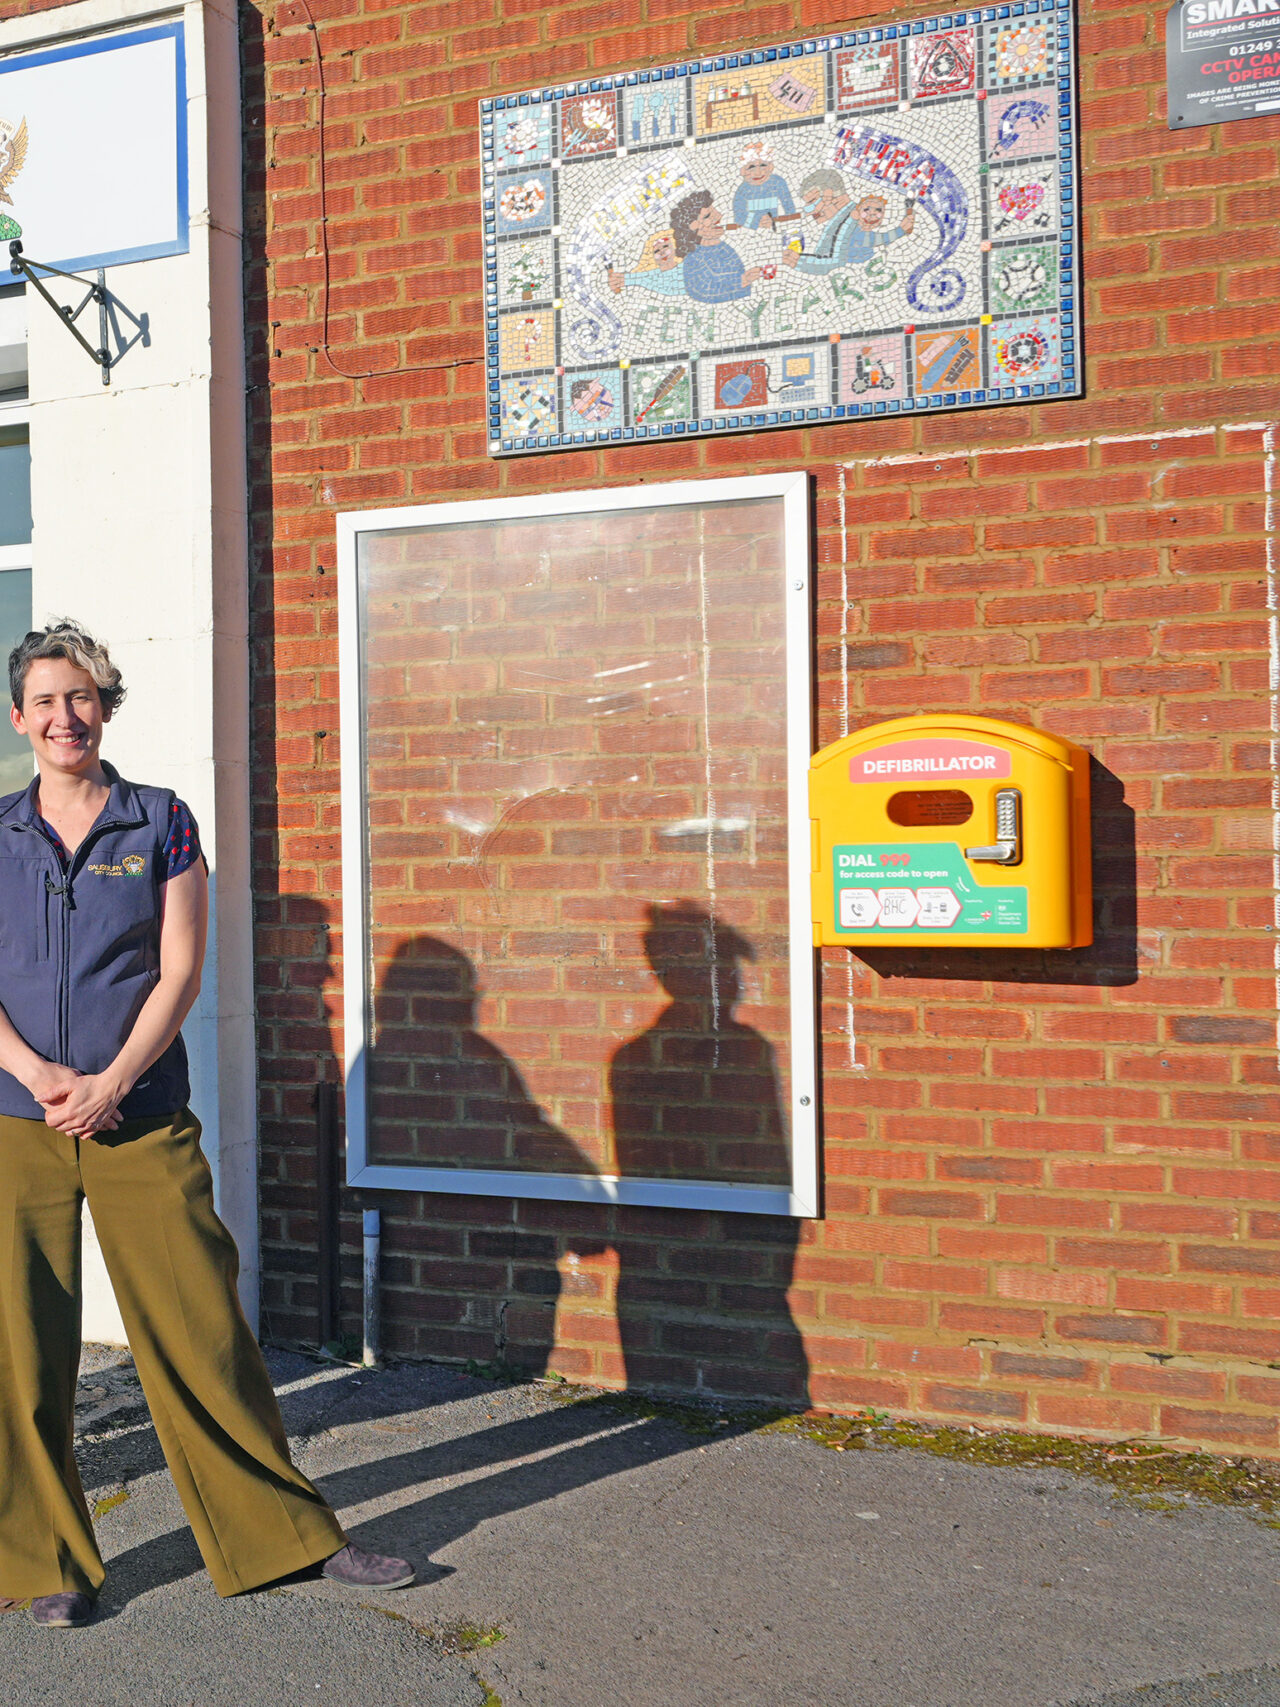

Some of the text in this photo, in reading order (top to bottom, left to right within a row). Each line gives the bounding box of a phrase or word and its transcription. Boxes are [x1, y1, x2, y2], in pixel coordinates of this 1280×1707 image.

[1186, 22, 1246, 39] Integrated
[1229, 40, 1273, 56] 01249
[1200, 57, 1245, 75] CCTV
[1186, 89, 1216, 99] IMAGES
[1217, 86, 1232, 94] ARE
[1233, 83, 1257, 92] BEING
[1210, 94, 1235, 102] CRIME
[635, 255, 898, 342] TEN YEARS
[863, 755, 996, 774] DEFIBRILLATOR
[839, 853, 911, 867] DIAL 999
[840, 869, 949, 880] for access code to open
[883, 897, 908, 916] BHC
